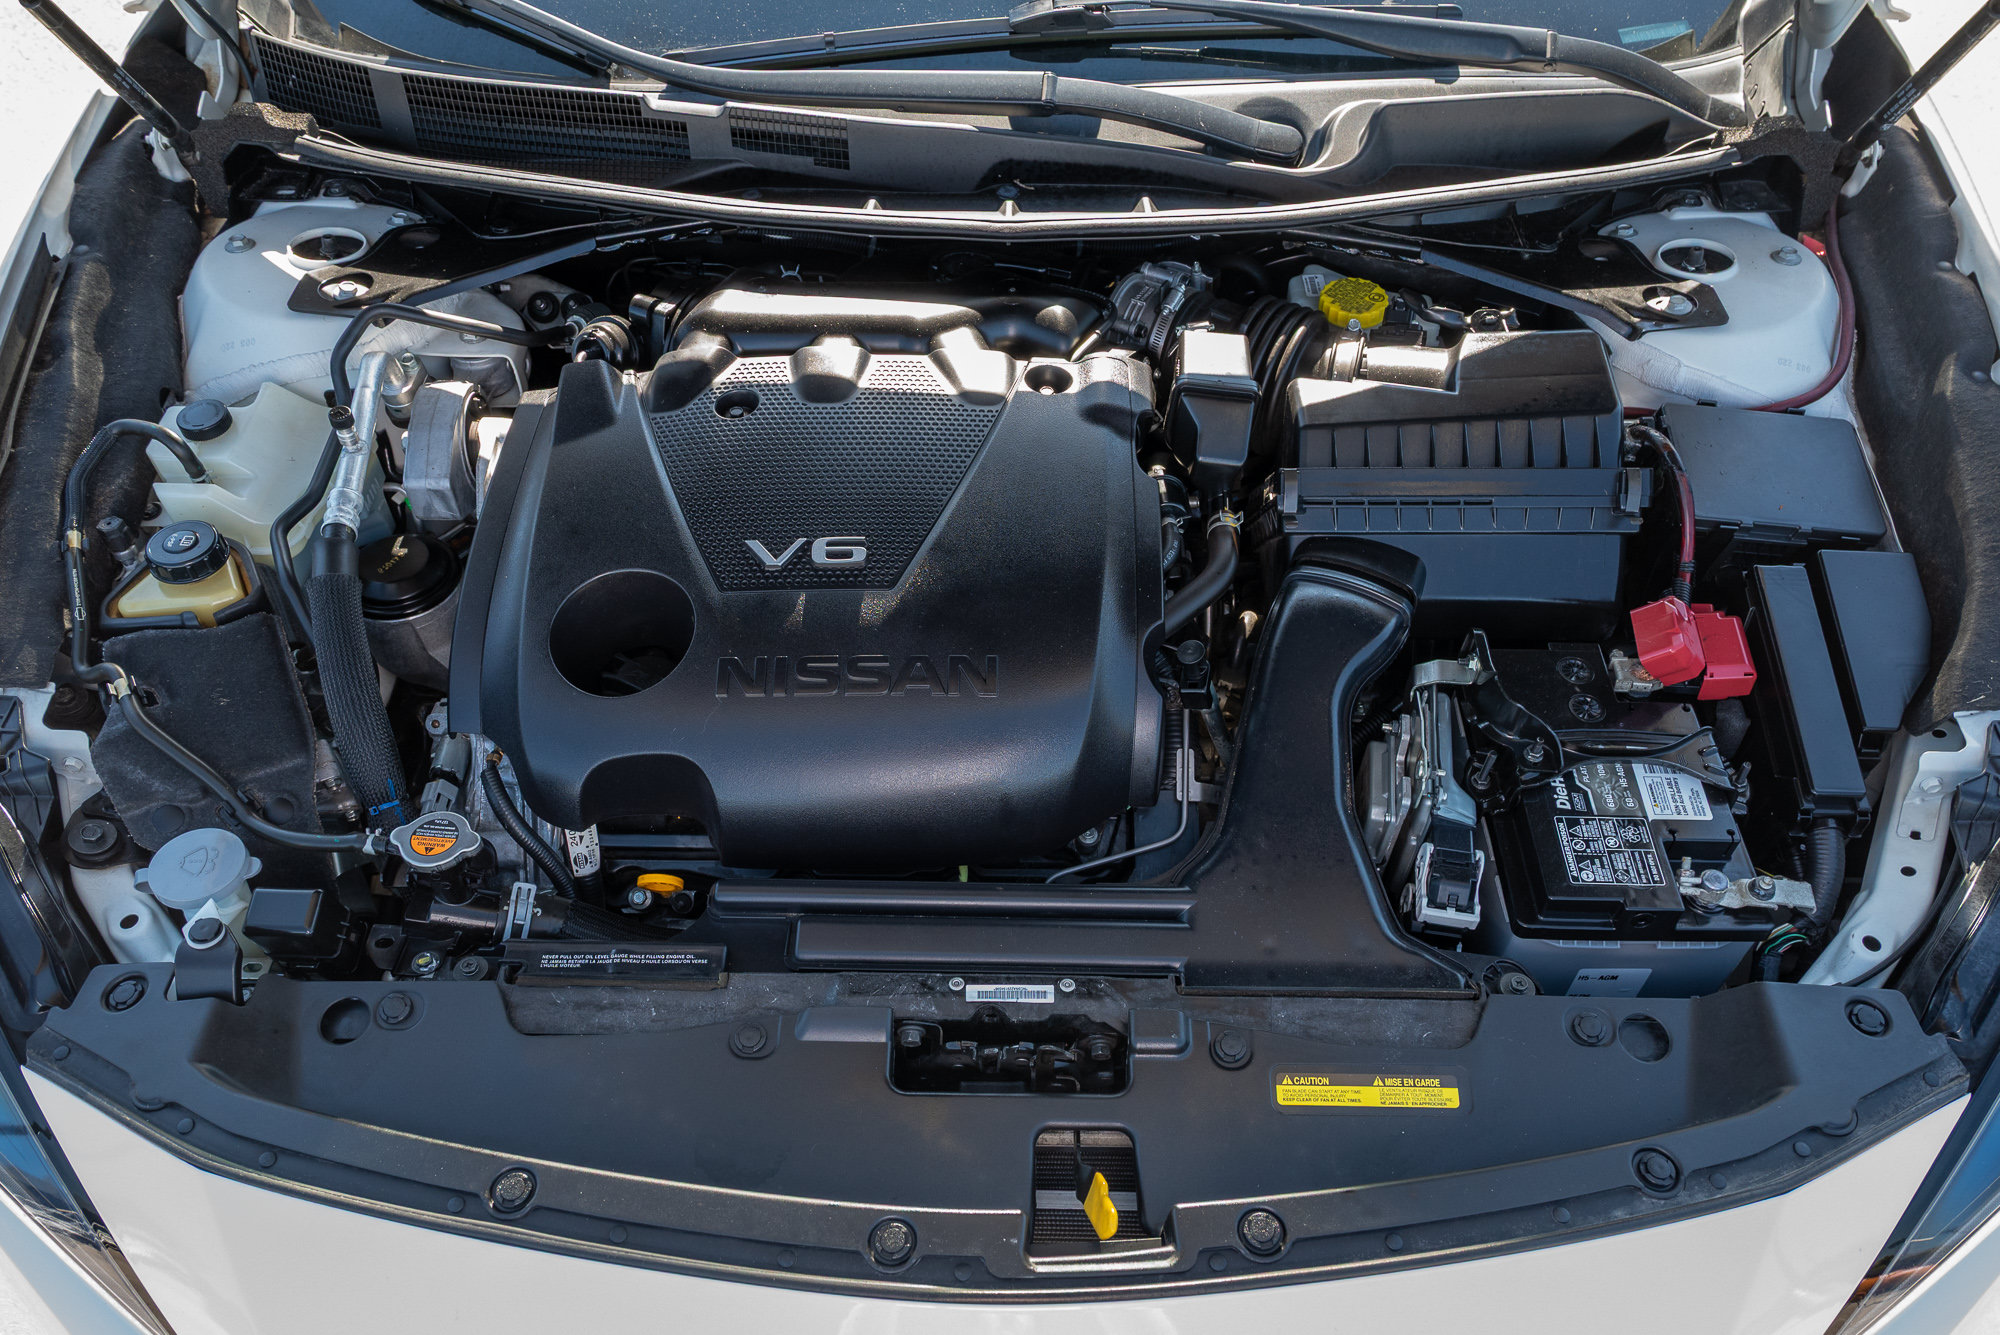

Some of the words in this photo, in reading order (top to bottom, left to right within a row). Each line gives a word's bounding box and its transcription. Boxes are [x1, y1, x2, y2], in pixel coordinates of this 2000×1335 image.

[744, 536, 868, 570] V6
[716, 654, 999, 698] NISSAN
[1605, 794, 1614, 807] 680
[1625, 797, 1634, 807] 60
[1558, 822, 1576, 872] DANGER/POISON
[1294, 1077, 1329, 1085] CAUTION
[1384, 1078, 1402, 1086] MISE
